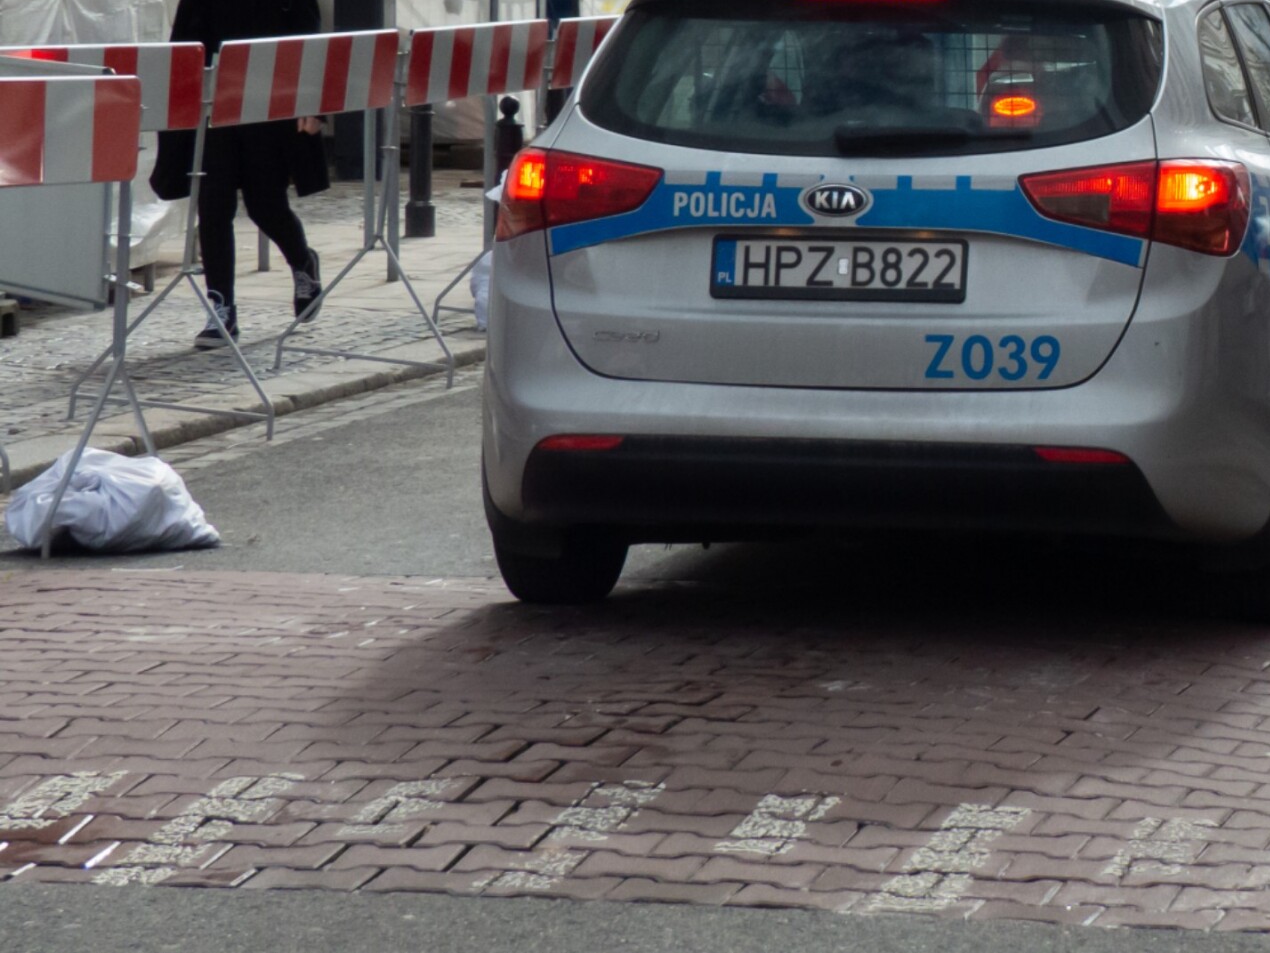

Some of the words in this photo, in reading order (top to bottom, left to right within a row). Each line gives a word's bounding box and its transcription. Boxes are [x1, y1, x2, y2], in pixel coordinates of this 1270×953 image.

[673, 191, 777, 218] POLICJA
[815, 191, 856, 209] KIA
[717, 271, 732, 283] PL
[742, 245, 834, 288] HPZ
[850, 247, 957, 289] B822
[925, 334, 1061, 381] Z039
